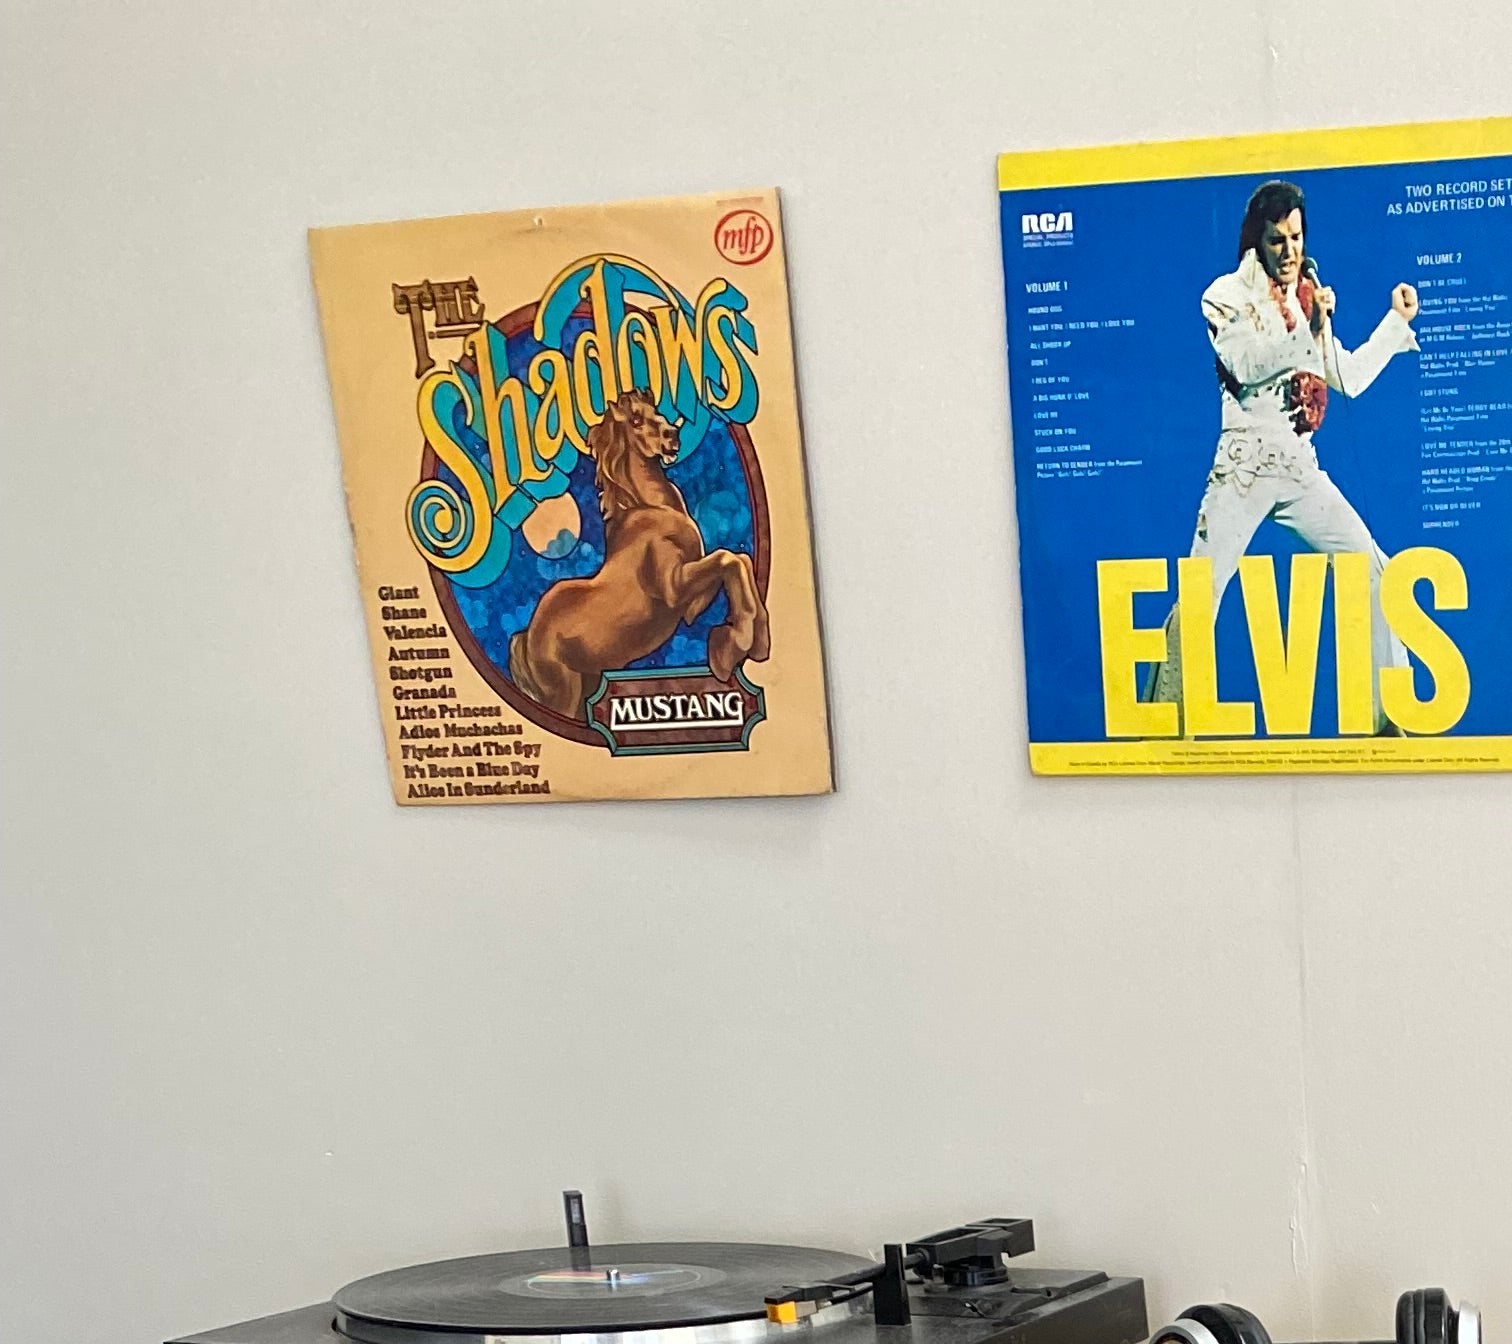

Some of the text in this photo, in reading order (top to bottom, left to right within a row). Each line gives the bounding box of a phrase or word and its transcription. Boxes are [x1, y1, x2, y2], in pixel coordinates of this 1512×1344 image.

[1405, 178, 1512, 197] TWO RECORD SET
[1387, 204, 1402, 216] AS
[1406, 197, 1484, 214] ADVERTISED
[1488, 195, 1505, 207] ON
[1022, 212, 1073, 233] RCA
[721, 218, 766, 256] mfp
[1417, 252, 1462, 266] VOLUME 2
[1026, 281, 1060, 293] VOLUME
[392, 276, 486, 378] THE
[406, 254, 758, 588] Shadows
[378, 586, 419, 601] Giant
[383, 624, 447, 641] Valencia
[1096, 547, 1471, 737] ELVIS
[388, 647, 450, 661] Autumn
[389, 666, 453, 682] Shotgun
[395, 704, 502, 720] Little Princess
[610, 691, 744, 722] MUSTANG
[399, 725, 440, 739] Adios
[451, 742, 482, 757] And
[483, 741, 512, 756] The
[513, 741, 541, 758] Spy
[408, 780, 551, 798] Alice In Sunderland
